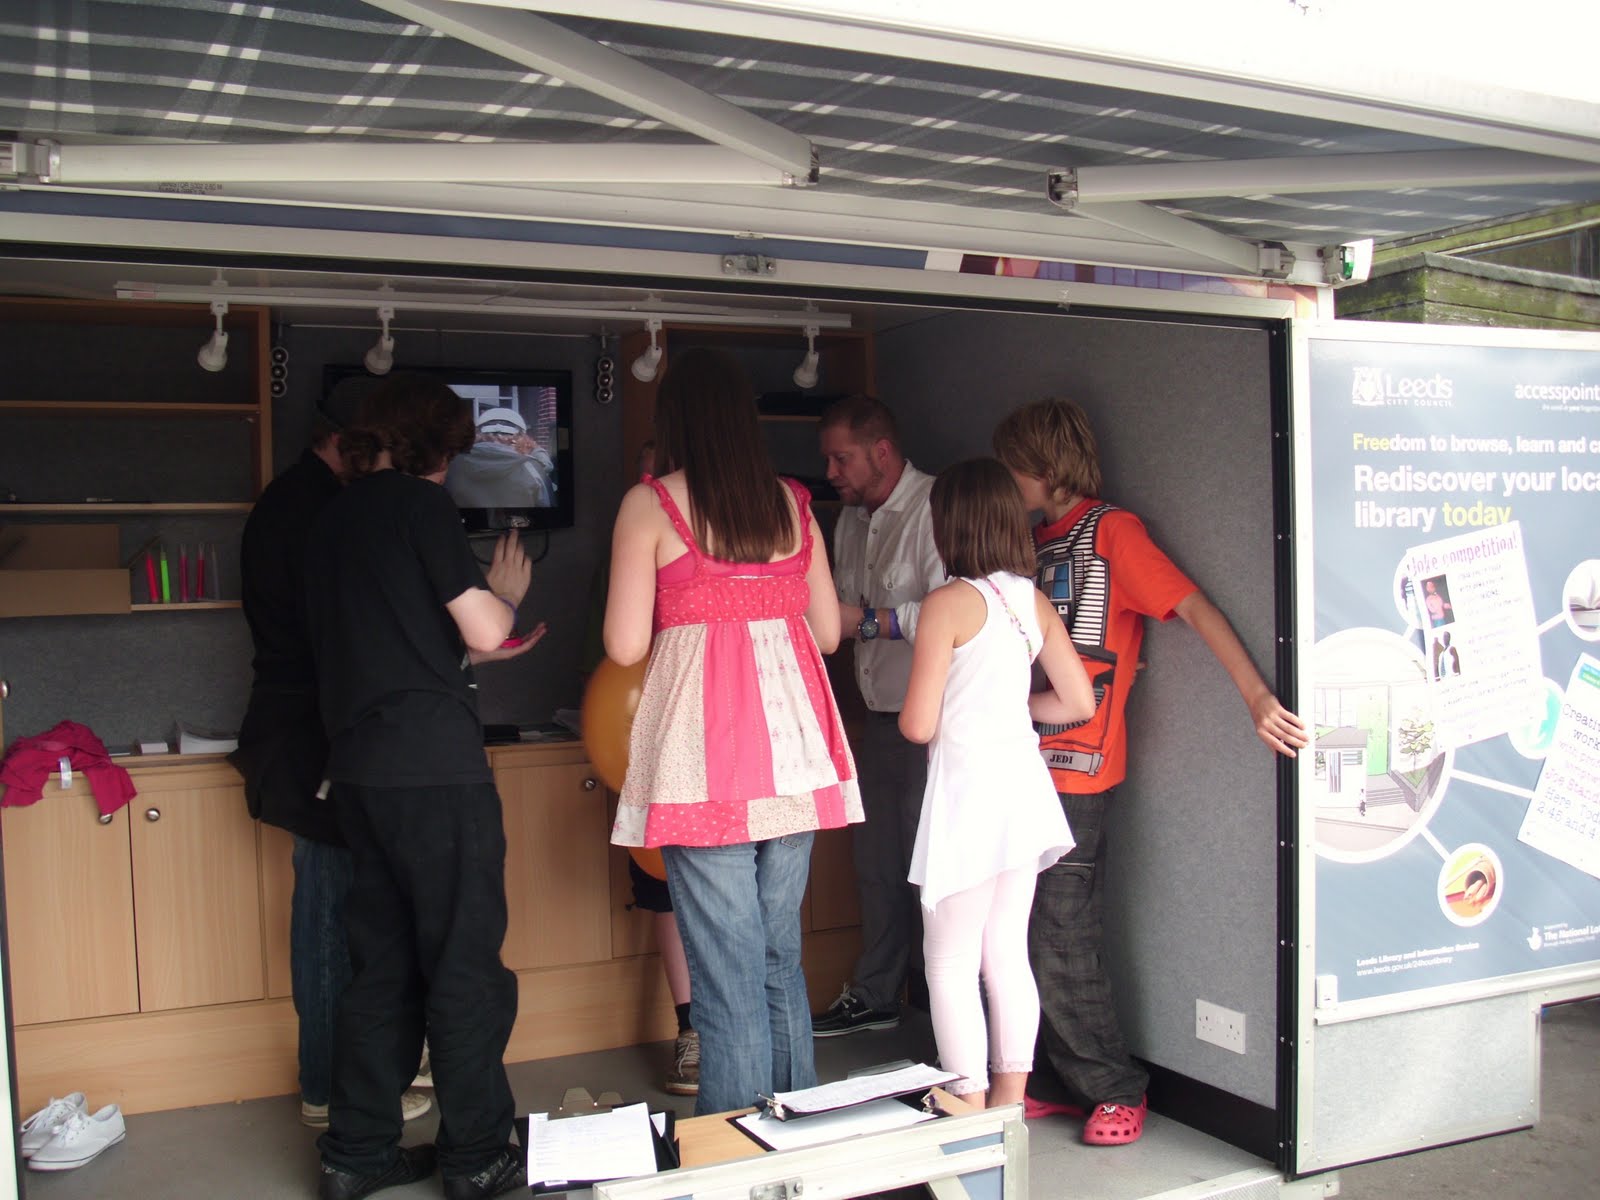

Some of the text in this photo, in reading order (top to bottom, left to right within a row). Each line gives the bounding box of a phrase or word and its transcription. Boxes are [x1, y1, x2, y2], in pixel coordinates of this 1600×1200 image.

[1386, 373, 1454, 399] Leeds
[1514, 382, 1600, 403] accesspoint
[1353, 432, 1426, 451] Freedom
[1430, 434, 1447, 451] to
[1450, 434, 1513, 455] browse,
[1516, 435, 1555, 453] learn
[1558, 436, 1586, 453] and
[1354, 464, 1497, 492] Rediscover
[1502, 469, 1556, 497] your
[1355, 500, 1512, 532] library today
[1410, 553, 1439, 577] Joke
[1562, 703, 1600, 733] Creati
[1049, 754, 1074, 764] JEDI
[1580, 803, 1600, 824] Tod
